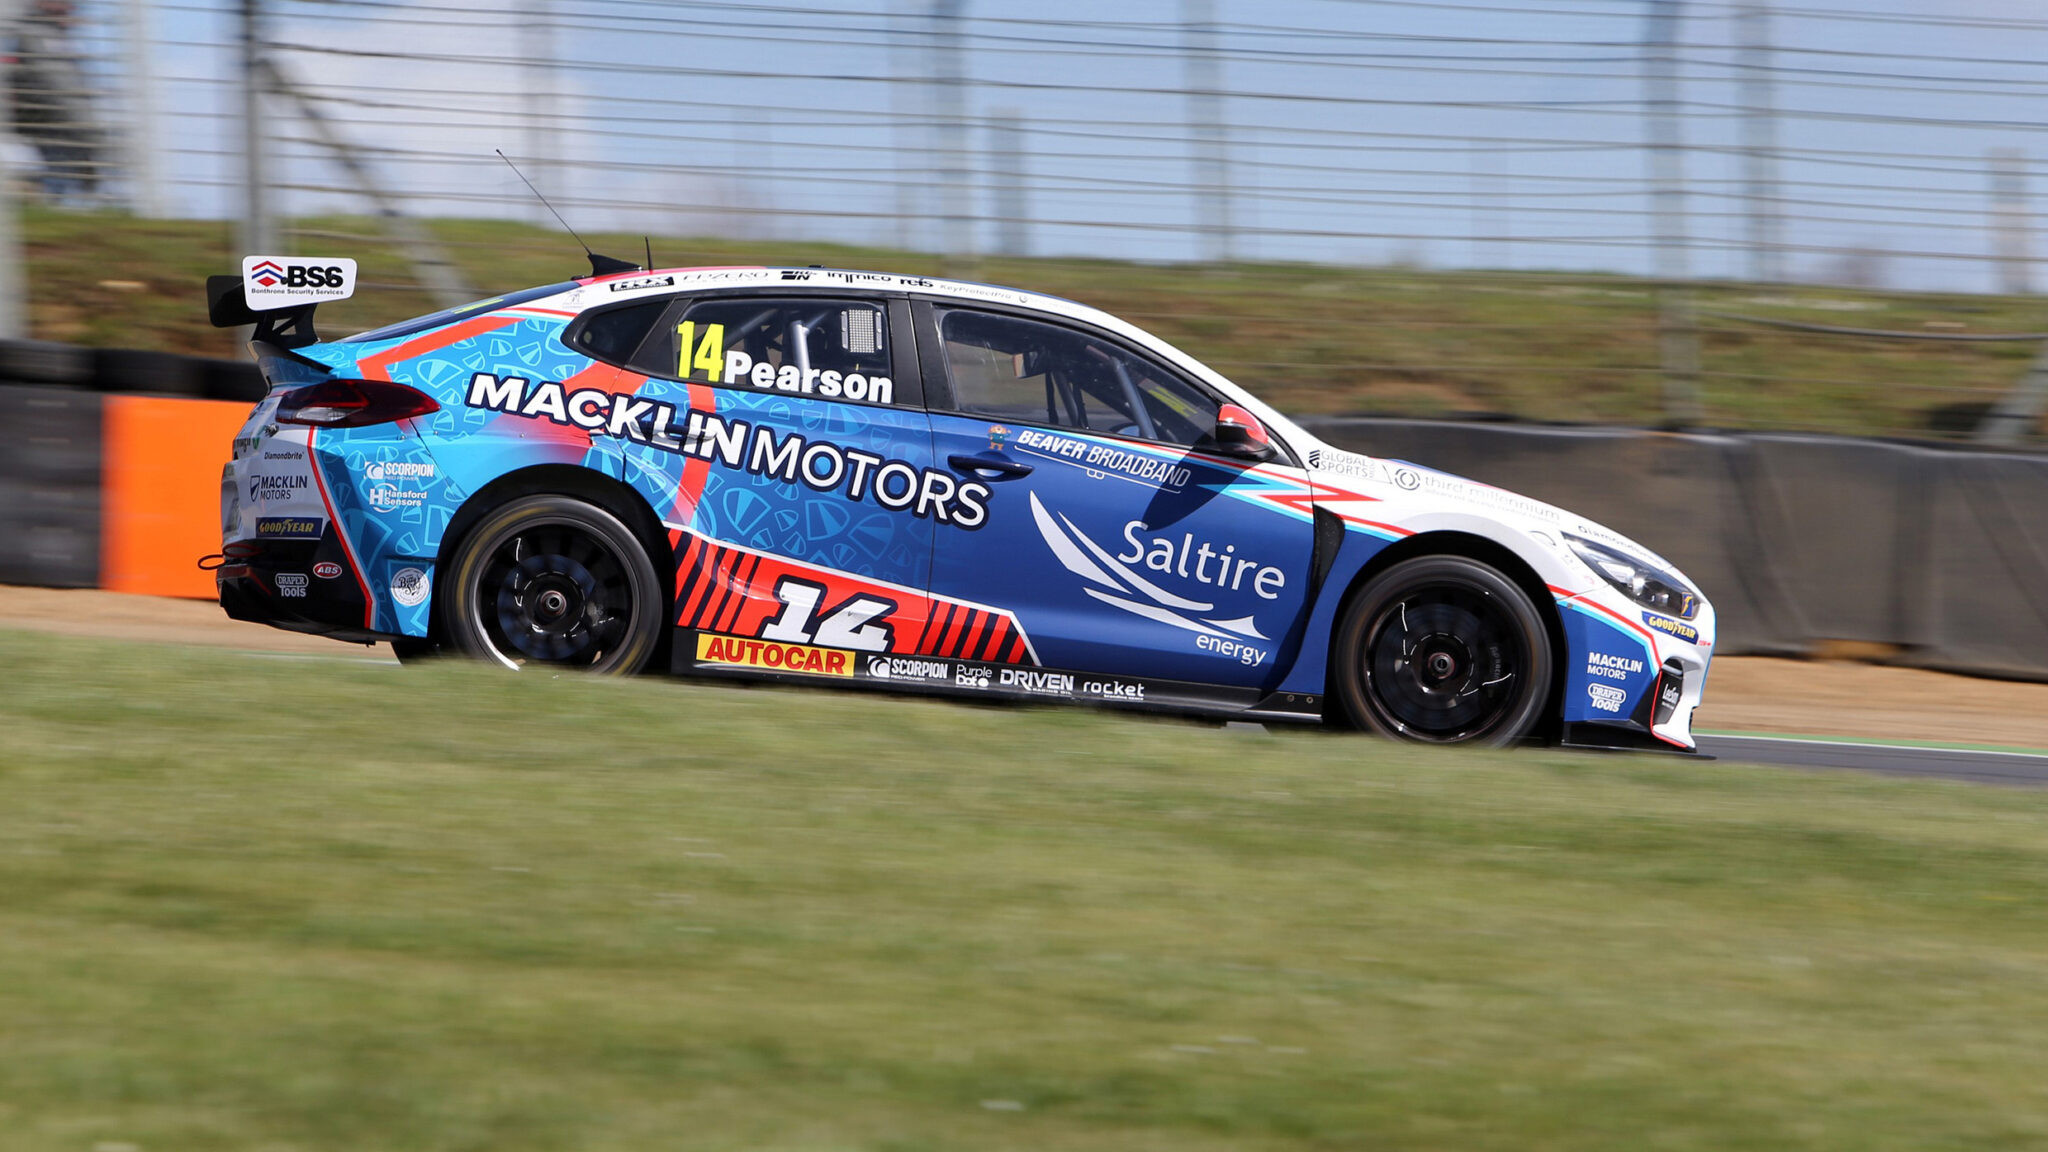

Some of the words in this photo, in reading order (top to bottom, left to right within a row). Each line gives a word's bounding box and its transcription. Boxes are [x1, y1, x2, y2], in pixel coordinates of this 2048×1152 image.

[677, 320, 725, 382] 14
[724, 350, 893, 404] Pearson
[264, 451, 303, 460] Diamondbrite
[470, 374, 748, 466] MACKLIN
[752, 430, 989, 526] MOTORS
[1017, 430, 1087, 459] BEAVER
[1086, 446, 1191, 487] BROADBAND
[1321, 450, 1368, 467] GLOBAL
[385, 462, 434, 477] SCORPION
[1320, 460, 1368, 478] SPORTS
[260, 475, 308, 489] MACKLIN
[1425, 476, 1463, 493] third
[260, 490, 291, 500] MOTORS
[383, 498, 422, 507] Sensors
[384, 490, 427, 499] Hansford
[1117, 520, 1286, 599] Saltire
[317, 566, 338, 574] ABS
[278, 576, 305, 585] DRAPER
[280, 585, 307, 597] Tools
[760, 580, 892, 653] 14
[705, 637, 846, 675] AUTOCAR
[1196, 634, 1267, 667] energy
[891, 658, 948, 679] SCORPION
[957, 663, 993, 679] Purple
[1588, 652, 1643, 674] MACKLIN
[956, 675, 977, 687] Dot
[1000, 669, 1075, 691] DRIVEN
[1587, 664, 1627, 681] MOTORS
[1083, 680, 1145, 697] rocket
[1591, 685, 1623, 701] DRAPER
[1591, 696, 1621, 713] Tools
